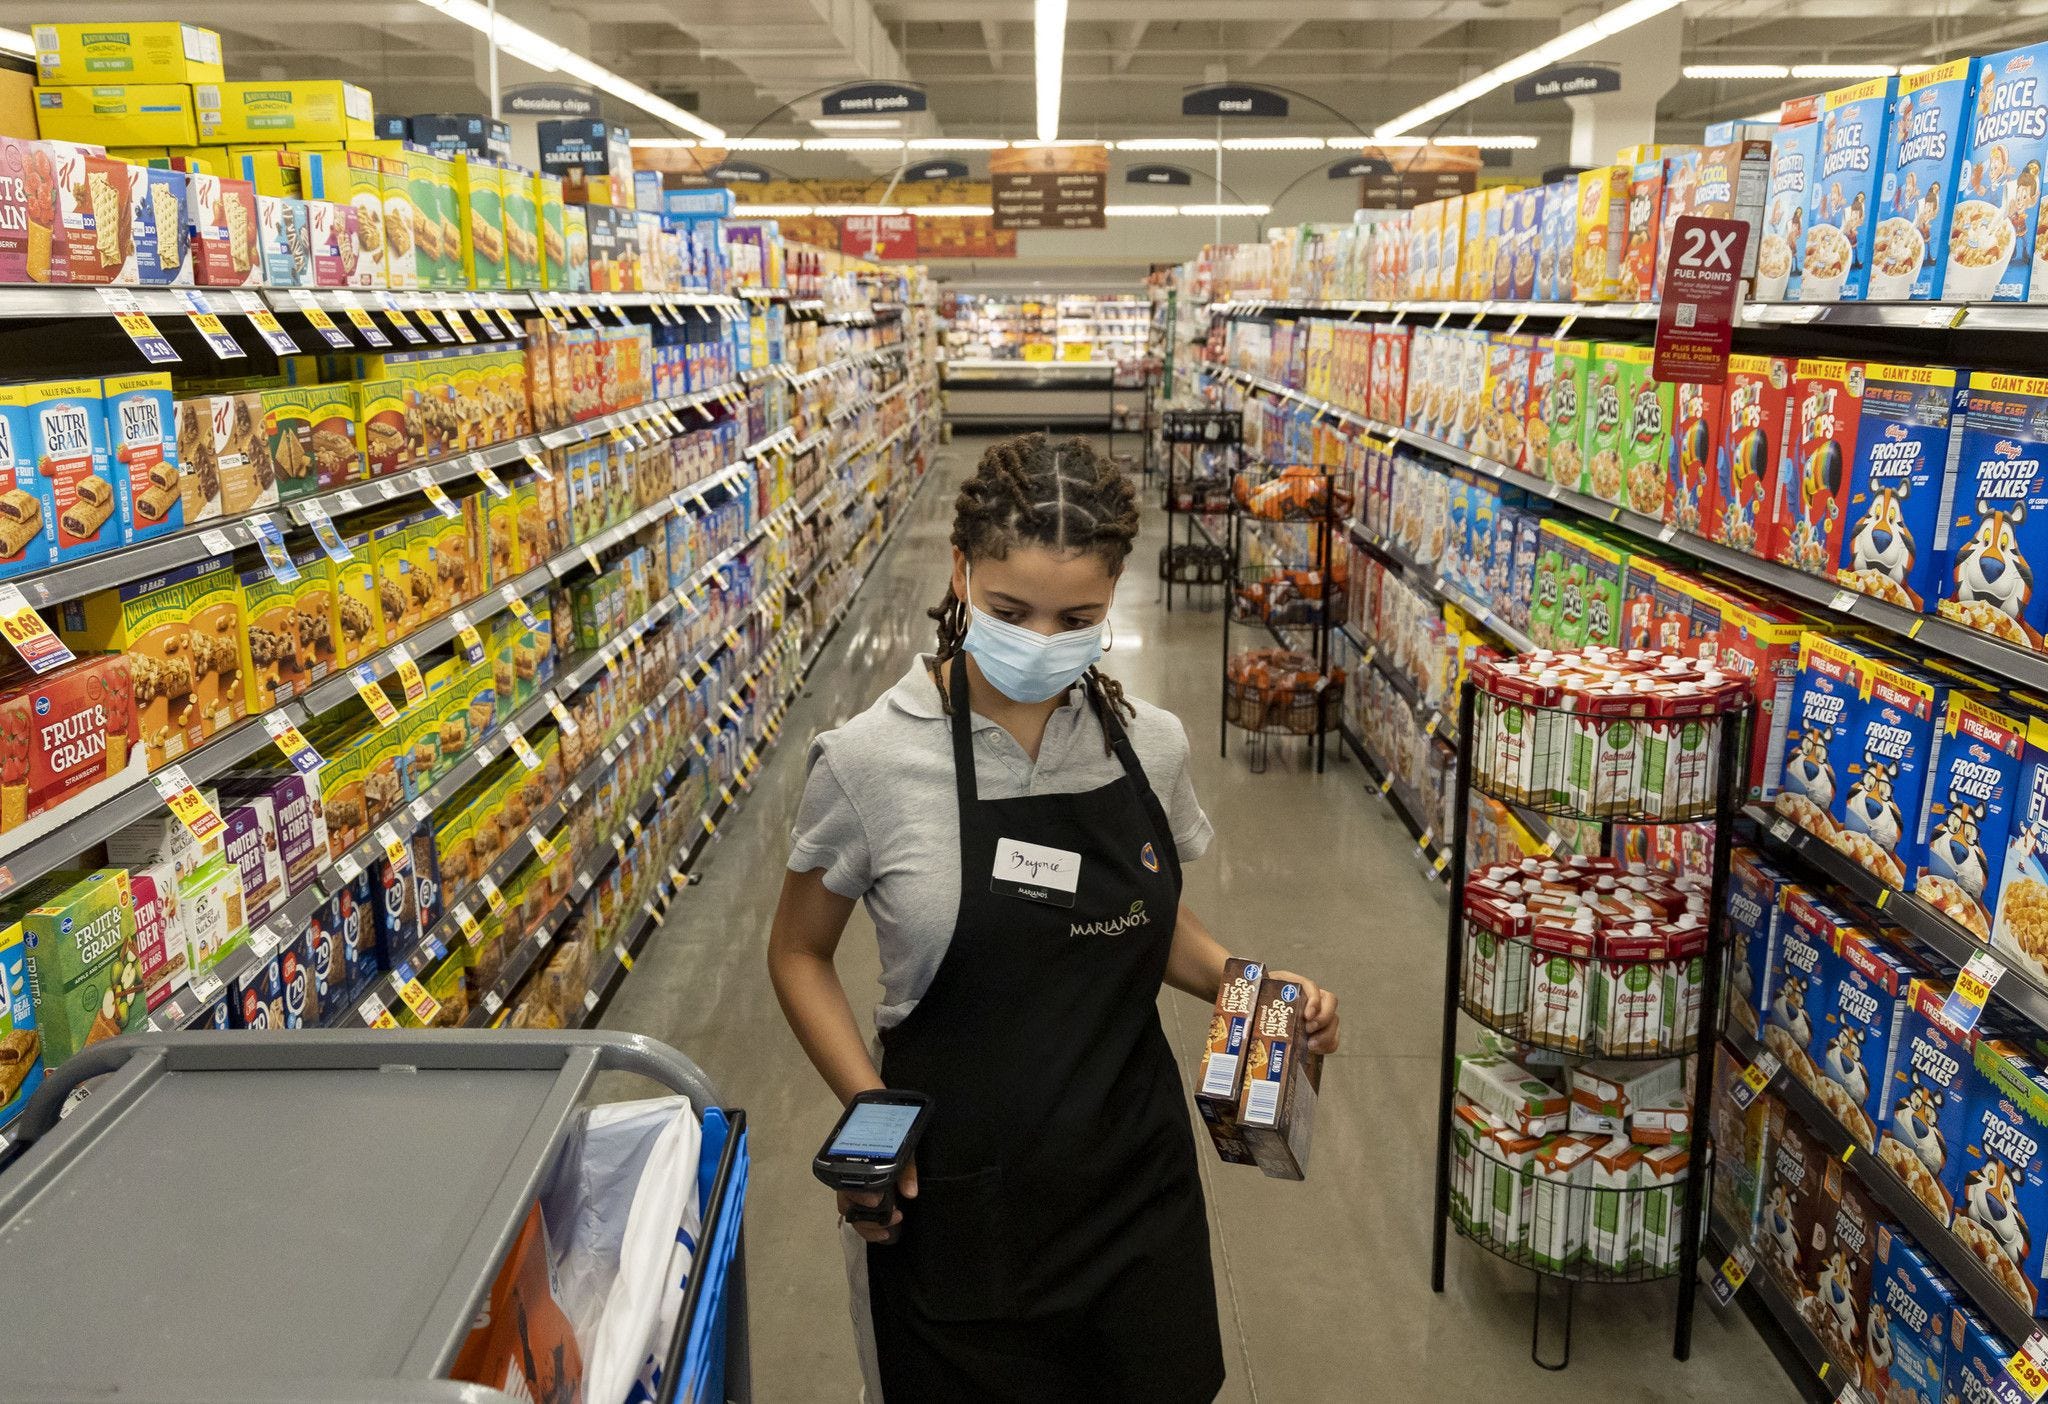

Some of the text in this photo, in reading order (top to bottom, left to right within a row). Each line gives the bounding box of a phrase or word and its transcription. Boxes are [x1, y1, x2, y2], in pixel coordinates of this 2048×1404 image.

[1536, 76, 1597, 95] bulk coffee
[1910, 66, 1954, 89] FAMILY SIZE
[513, 97, 591, 112] chocolate chips
[840, 95, 908, 111] sweet goods
[1218, 99, 1252, 111] cereal
[1835, 85, 1874, 104] FAMILY SIZE
[1993, 79, 2038, 111] RICE
[1912, 109, 1939, 136] RICE
[1974, 105, 2048, 147] KRISPIES
[1836, 124, 1862, 147] RICE
[545, 151, 603, 162] SNACK MIX
[1898, 133, 1946, 168] KRISPIES
[1823, 146, 1870, 179] KRISPIES
[1702, 165, 1727, 186] COCOA
[1695, 183, 1732, 206] KRISPIES
[846, 217, 911, 231] GREA PRICE
[1678, 227, 1737, 270] 2X
[1674, 269, 1732, 282] FUEL POINTS
[124, 318, 150, 330] 3.19
[195, 316, 218, 327] 3.19
[145, 341, 173, 357] 2.19
[1671, 344, 1712, 353] PLUS EARN
[1672, 351, 1691, 360] FUEL
[1693, 353, 1721, 363] POINTS
[1729, 357, 1768, 372] GIANT SIZE
[1800, 362, 1843, 378] GIANT SIZE
[1883, 367, 1932, 382] GIANT SIZE
[41, 388, 60, 396] VALUE
[1991, 376, 2048, 397] GIANT SIZE
[123, 404, 157, 426] NUTRI
[1969, 398, 1988, 412] GET
[46, 413, 86, 437] NUTRI
[126, 420, 159, 440] GRAIN
[1802, 415, 1835, 445] LOOPS
[49, 429, 88, 452] GRAIN
[1870, 441, 1922, 461] FROSTED
[15, 467, 34, 477] FRUIT
[1870, 459, 1914, 478] FLAKES
[1976, 460, 2040, 480] FROSTED
[1976, 479, 2031, 499] FLAKES
[206, 560, 220, 572] BARS
[149, 578, 166, 590] BARS
[126, 587, 183, 628] NATURE VALLEY
[4, 613, 44, 641] 6.69
[1775, 628, 1801, 636] FAMILY
[1812, 640, 1848, 660] LARGE SIZE
[1728, 648, 1755, 677] FRUIT
[1814, 657, 1826, 670] FREE
[1826, 662, 1841, 677] BOOK
[1875, 667, 1916, 692] LARGE SIZE
[1803, 690, 1844, 712] FROSTED
[1877, 684, 1910, 709] 1 FREE BOOK
[1803, 704, 1838, 725] FLAKES
[1964, 700, 2008, 728] LARGE SIZE
[41, 704, 107, 751] FRUIT &
[1865, 721, 1912, 746] FROSTED
[1964, 718, 2003, 746] 1 FREE BOOK
[50, 729, 106, 773] GRAIN
[283, 733, 300, 749] 4.99
[1865, 737, 1906, 760] FLAKES
[1600, 750, 1637, 763] Oatmilk
[65, 764, 100, 787] STRAWBERRY
[1950, 758, 2001, 786] FROSTED
[1950, 775, 1993, 800] FLAKES
[174, 794, 199, 813] 7.99
[279, 795, 306, 825] PROTEIN
[282, 813, 310, 842] & FIBER
[227, 828, 259, 861] PROTEIN
[389, 884, 401, 903] 70
[75, 906, 121, 949] FRUIT &
[136, 924, 160, 954] IBER
[82, 925, 121, 963] GRAIN
[316, 944, 328, 966] 70
[1783, 934, 1819, 963] FROSTED
[1783, 948, 1814, 974] FLAKES
[1848, 947, 1877, 976] FREE BOOK
[1960, 976, 1985, 999] 2/5.00
[1982, 970, 1998, 984] 3.19
[292, 979, 304, 999] 70
[1223, 977, 1247, 1013] & Salty
[1240, 980, 1256, 1014] Sweet
[1537, 982, 1579, 999] Oatmilk
[1617, 993, 1657, 1004] Oatmilk
[1837, 980, 1879, 1011] FROSTED
[13, 996, 30, 1012] REAL
[14, 1007, 31, 1023] FRUIT
[1838, 996, 1873, 1025] FLAKES
[1262, 999, 1286, 1038] & Salty
[1276, 1004, 1294, 1038] Sweet
[1231, 1025, 1242, 1047] ALMOND
[1271, 1049, 1284, 1073] ALMOND
[1910, 1036, 1960, 1075] FROSTED
[1747, 1068, 1763, 1086] 2.99
[1910, 1054, 1952, 1088] FLAKES
[75, 1088, 89, 1101] 4.29
[1981, 1110, 2038, 1156] FROSTED
[1981, 1128, 2030, 1169] FLAKES
[1835, 1210, 1866, 1245] FROSTED
[1835, 1223, 1861, 1254] FLAKES
[1727, 1261, 1741, 1281] 2.99
[1885, 1276, 1928, 1324] FROSTED
[1886, 1293, 1923, 1333] FLAKES
[2014, 1358, 2041, 1388] 2.99
[1997, 1380, 2023, 1404] 1.99
